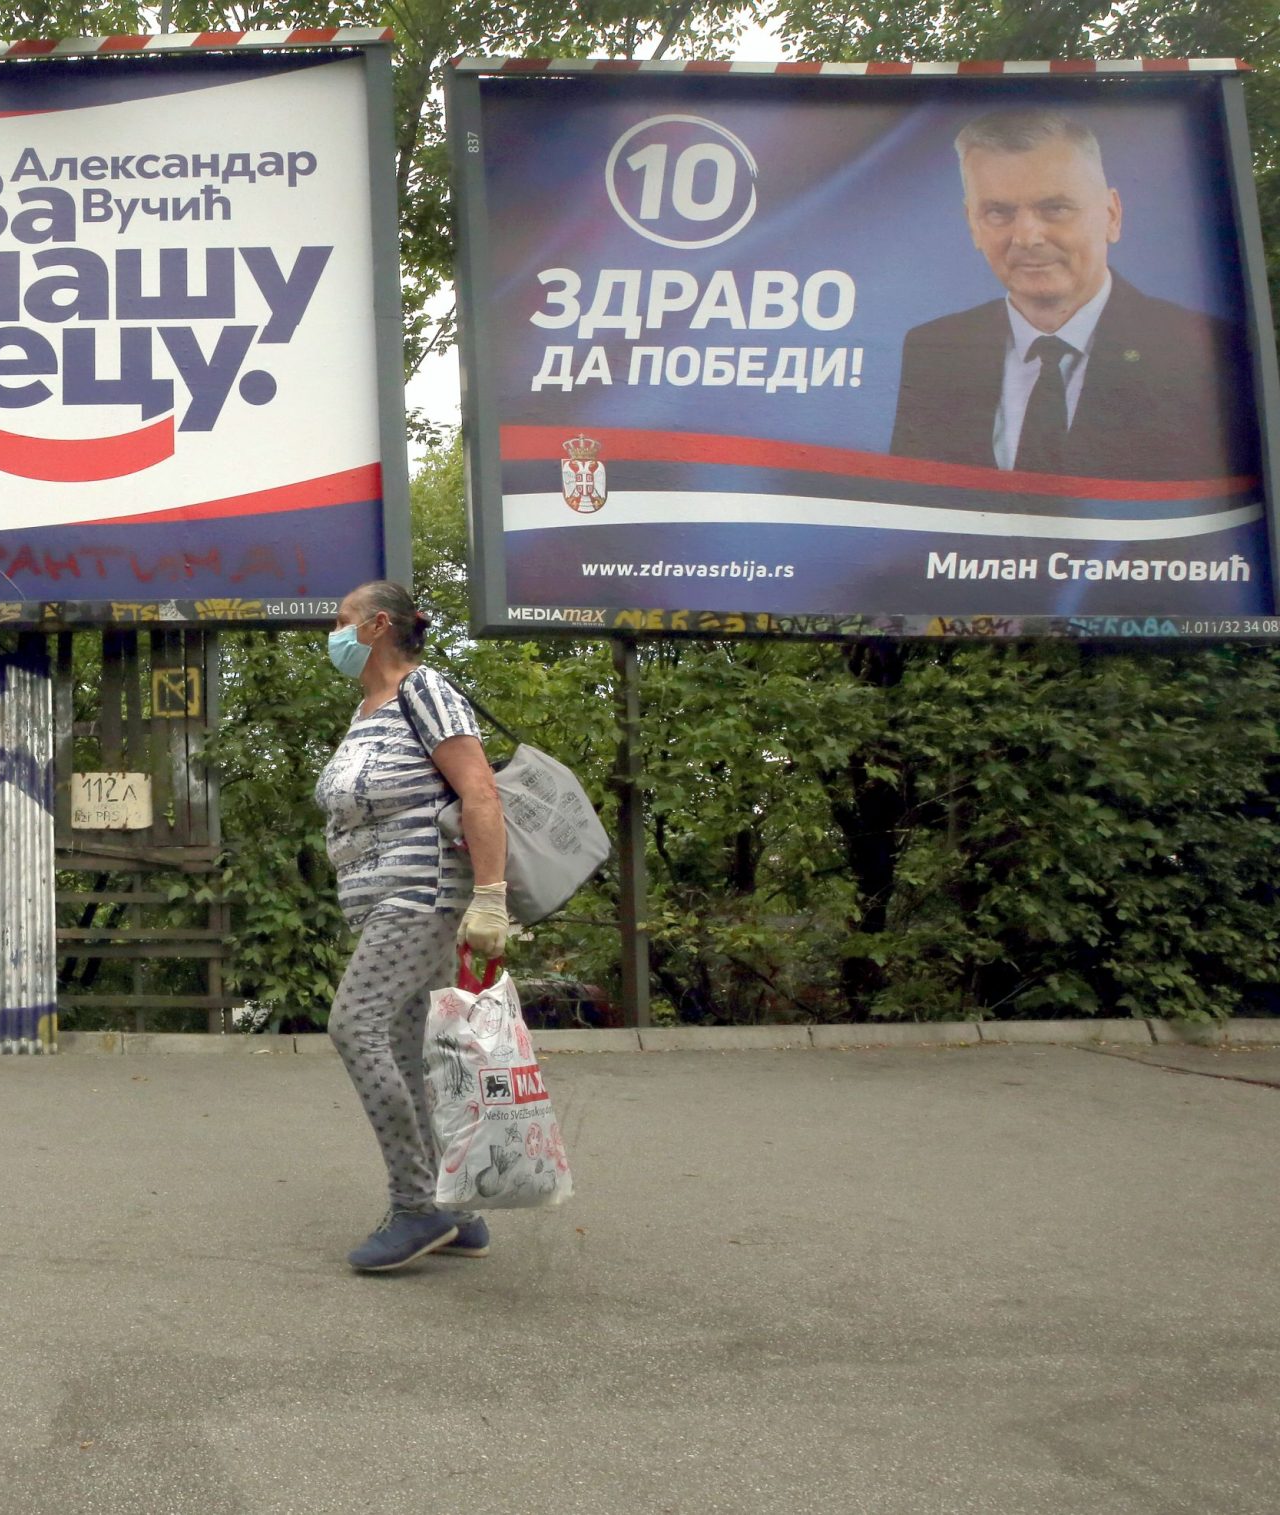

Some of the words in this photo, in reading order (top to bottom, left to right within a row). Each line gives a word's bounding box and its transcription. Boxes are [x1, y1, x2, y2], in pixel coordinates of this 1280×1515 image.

[467, 131, 480, 153] 837
[10, 147, 318, 187] Александар
[626, 142, 736, 221] 10
[82, 185, 232, 233] Вучић
[529, 268, 856, 339] ЗДРАВО
[531, 346, 613, 392] ДА
[627, 346, 864, 393] ПОБЕДИ!
[581, 560, 795, 581] www.zdravasrbija.rs
[926, 552, 1038, 580] Милан
[1047, 552, 1251, 582] Стаматовић
[1243, 621, 1259, 634] 34
[1262, 620, 1280, 634] 08
